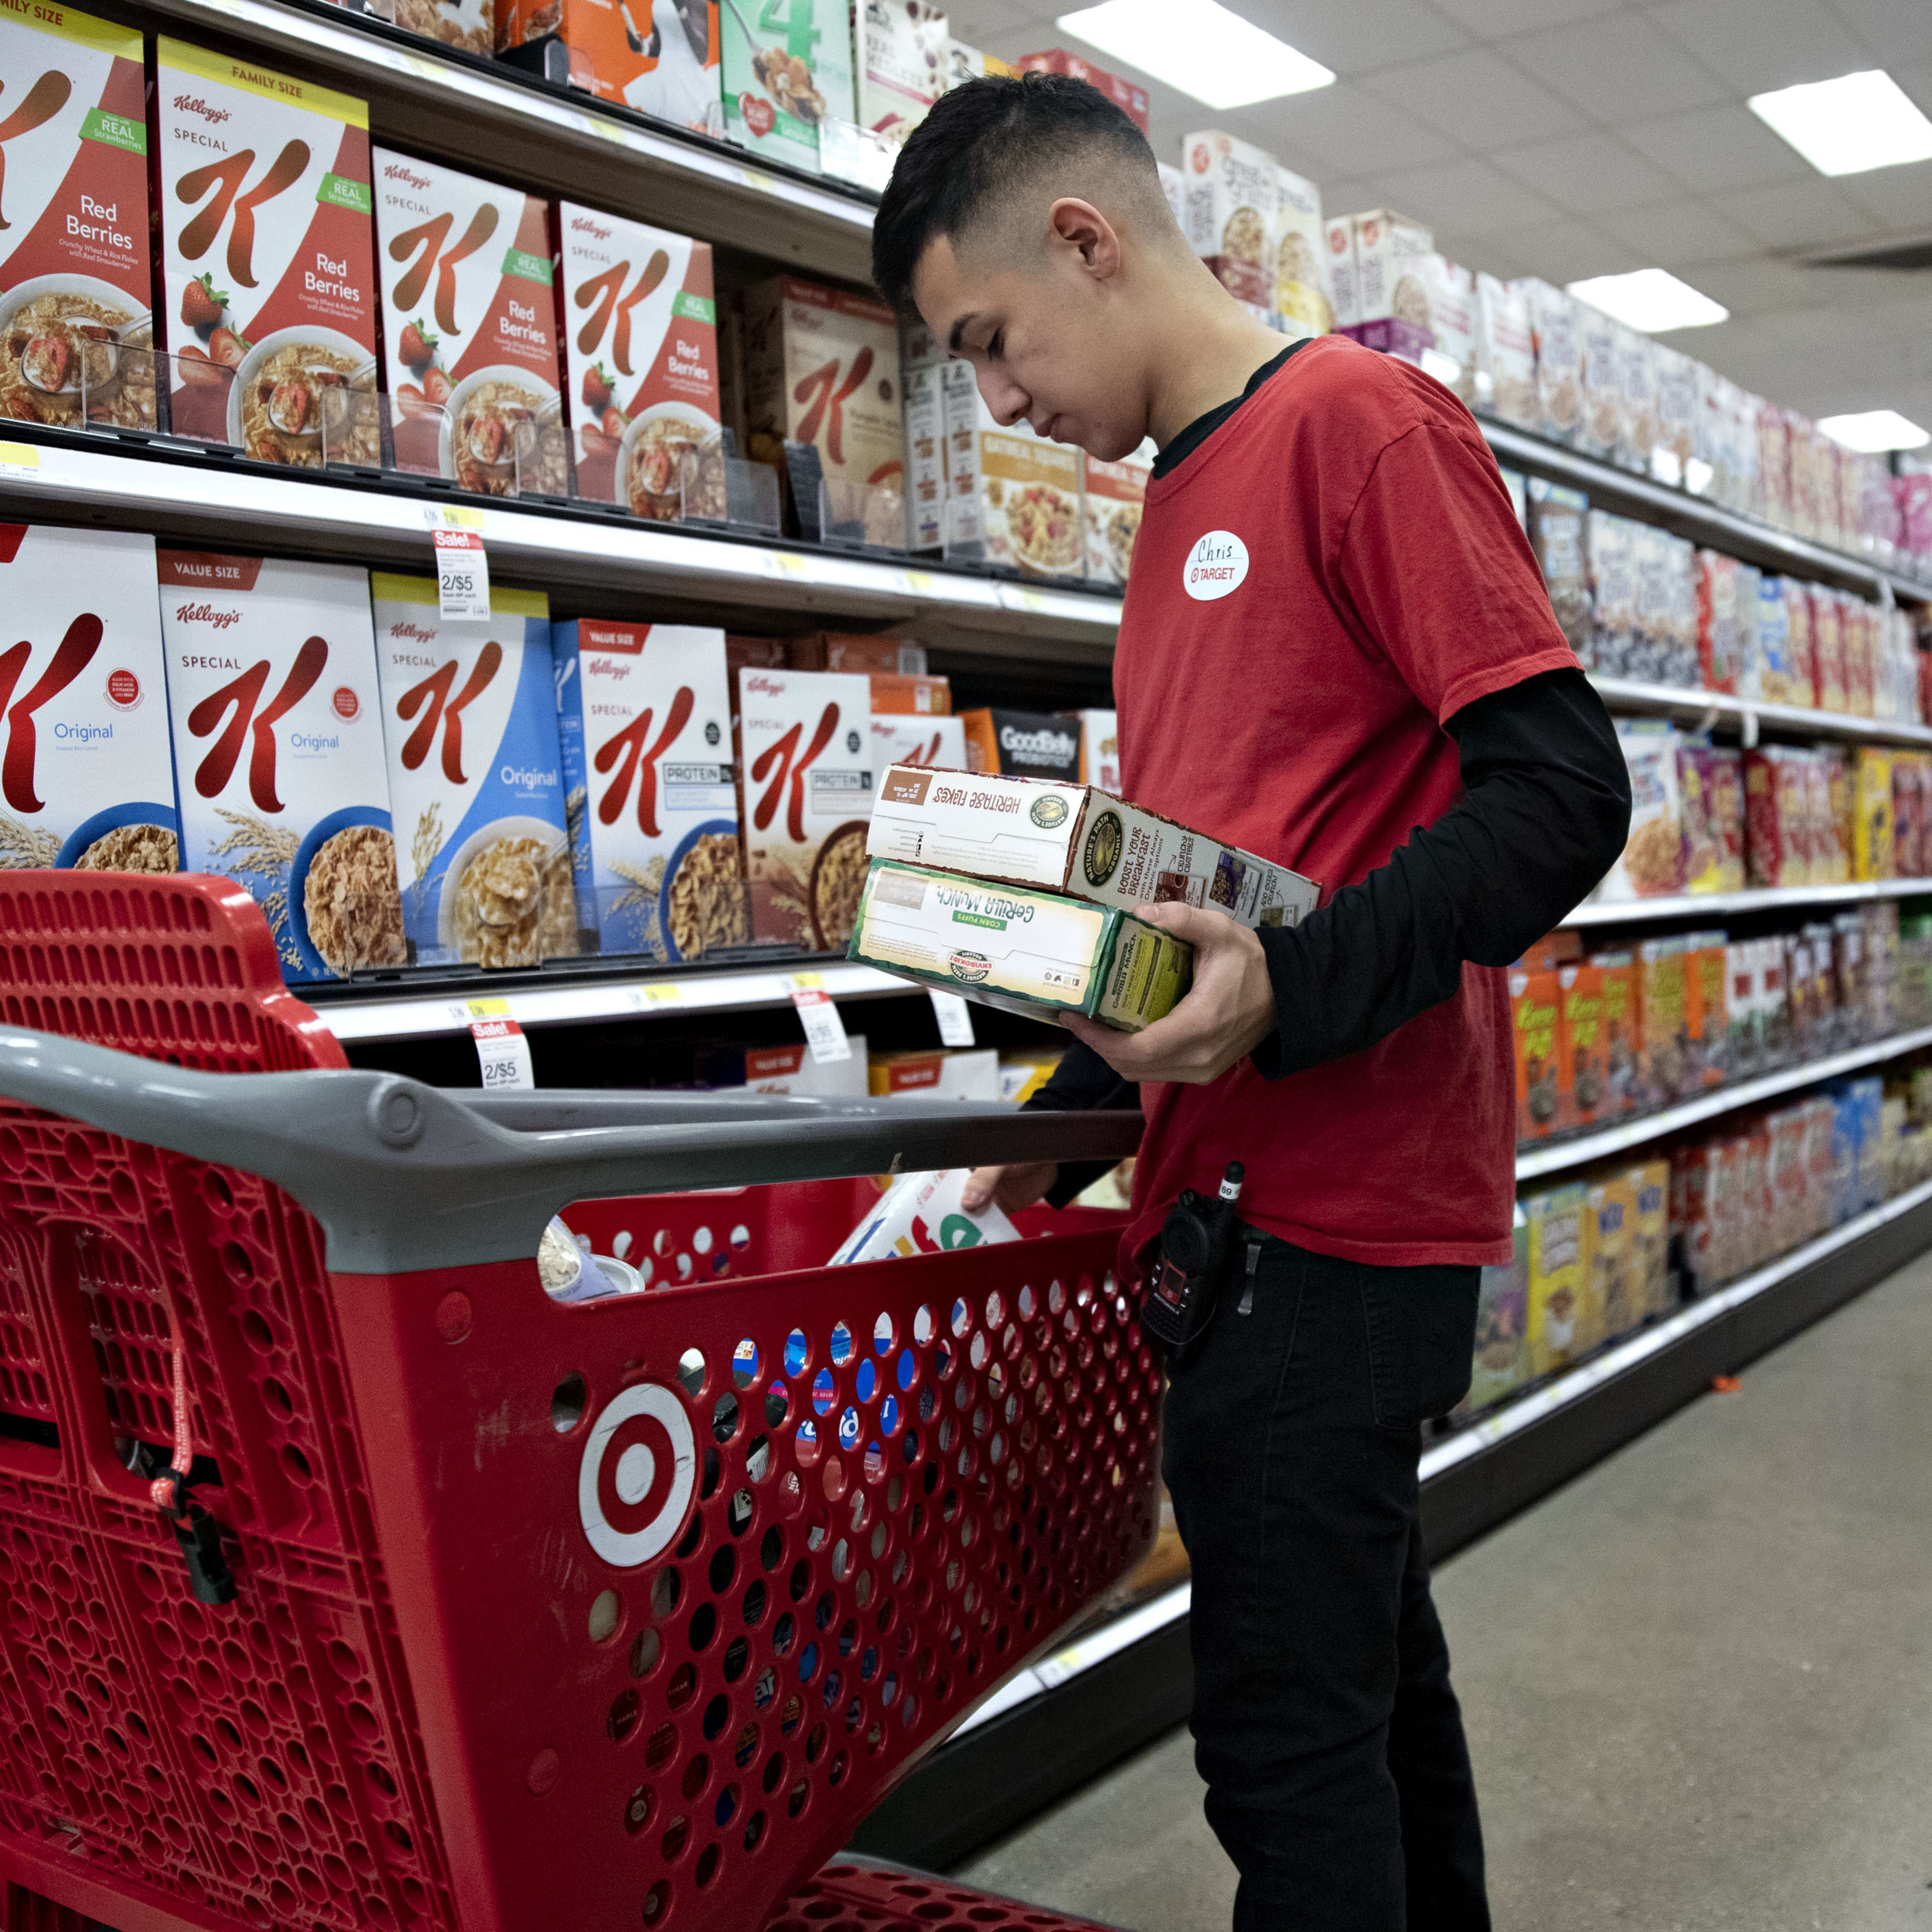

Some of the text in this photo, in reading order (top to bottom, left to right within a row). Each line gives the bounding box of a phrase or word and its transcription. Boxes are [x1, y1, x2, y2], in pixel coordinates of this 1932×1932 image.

[34, 6, 63, 26] SIZE
[232, 66, 302, 98] FAMILY SIZE
[174, 95, 229, 123] Kellogg's
[94, 129, 142, 150] Strawberries
[102, 120, 135, 139] REAL
[175, 128, 227, 152] SPECIAL
[334, 183, 361, 200] REAL
[81, 195, 117, 222] Red
[176, 139, 310, 288] K
[386, 195, 431, 215] SPECIAL
[67, 214, 132, 250] Berries
[59, 238, 83, 252] Crunchy
[85, 245, 103, 255] Wheat
[109, 252, 121, 260] Rice
[122, 254, 138, 264] Flakes
[69, 250, 130, 270] with Real Strawberries
[317, 253, 347, 277] Red
[388, 203, 499, 336] K
[305, 271, 360, 302] Berries
[509, 300, 535, 323] Red
[575, 250, 669, 376] K
[500, 316, 546, 344] Berries
[676, 340, 700, 360] Red
[669, 355, 709, 380] Berries
[435, 531, 470, 547] Sale!
[1198, 538, 1232, 563] Chris
[174, 562, 240, 579] VALUE SIZE
[1200, 568, 1235, 580] TARGET
[442, 575, 472, 591] 2/$5
[177, 603, 240, 629] Kellogg's
[182, 656, 240, 669] SPECIAL
[393, 655, 436, 667] SPECIAL
[397, 641, 503, 784] K
[54, 723, 113, 742] Original
[188, 636, 328, 814] K
[291, 734, 339, 751] Original
[594, 686, 694, 838] K
[751, 702, 840, 843] K
[501, 766, 558, 790] Original
[668, 768, 717, 780] PROTEIN
[1041, 816, 1065, 827] NATURE'S
[1086, 815, 1108, 880] NATURE'S PATH
[1128, 827, 1142, 855] YOUR
[1108, 834, 1120, 872] ORGANIC
[1145, 858, 1153, 879] these
[1150, 830, 1159, 856] Always
[1145, 838, 1163, 900] Organic options
[958, 913, 1000, 928] CORN PUFFS
[949, 955, 992, 969] ENVIROKIDZ
[961, 952, 982, 960] ORGANIC
[952, 964, 986, 981] NATURE'S PATH
[472, 1022, 509, 1037] Sale!
[485, 1062, 516, 1079] 2/$5
[1221, 1186, 1232, 1195] 69
